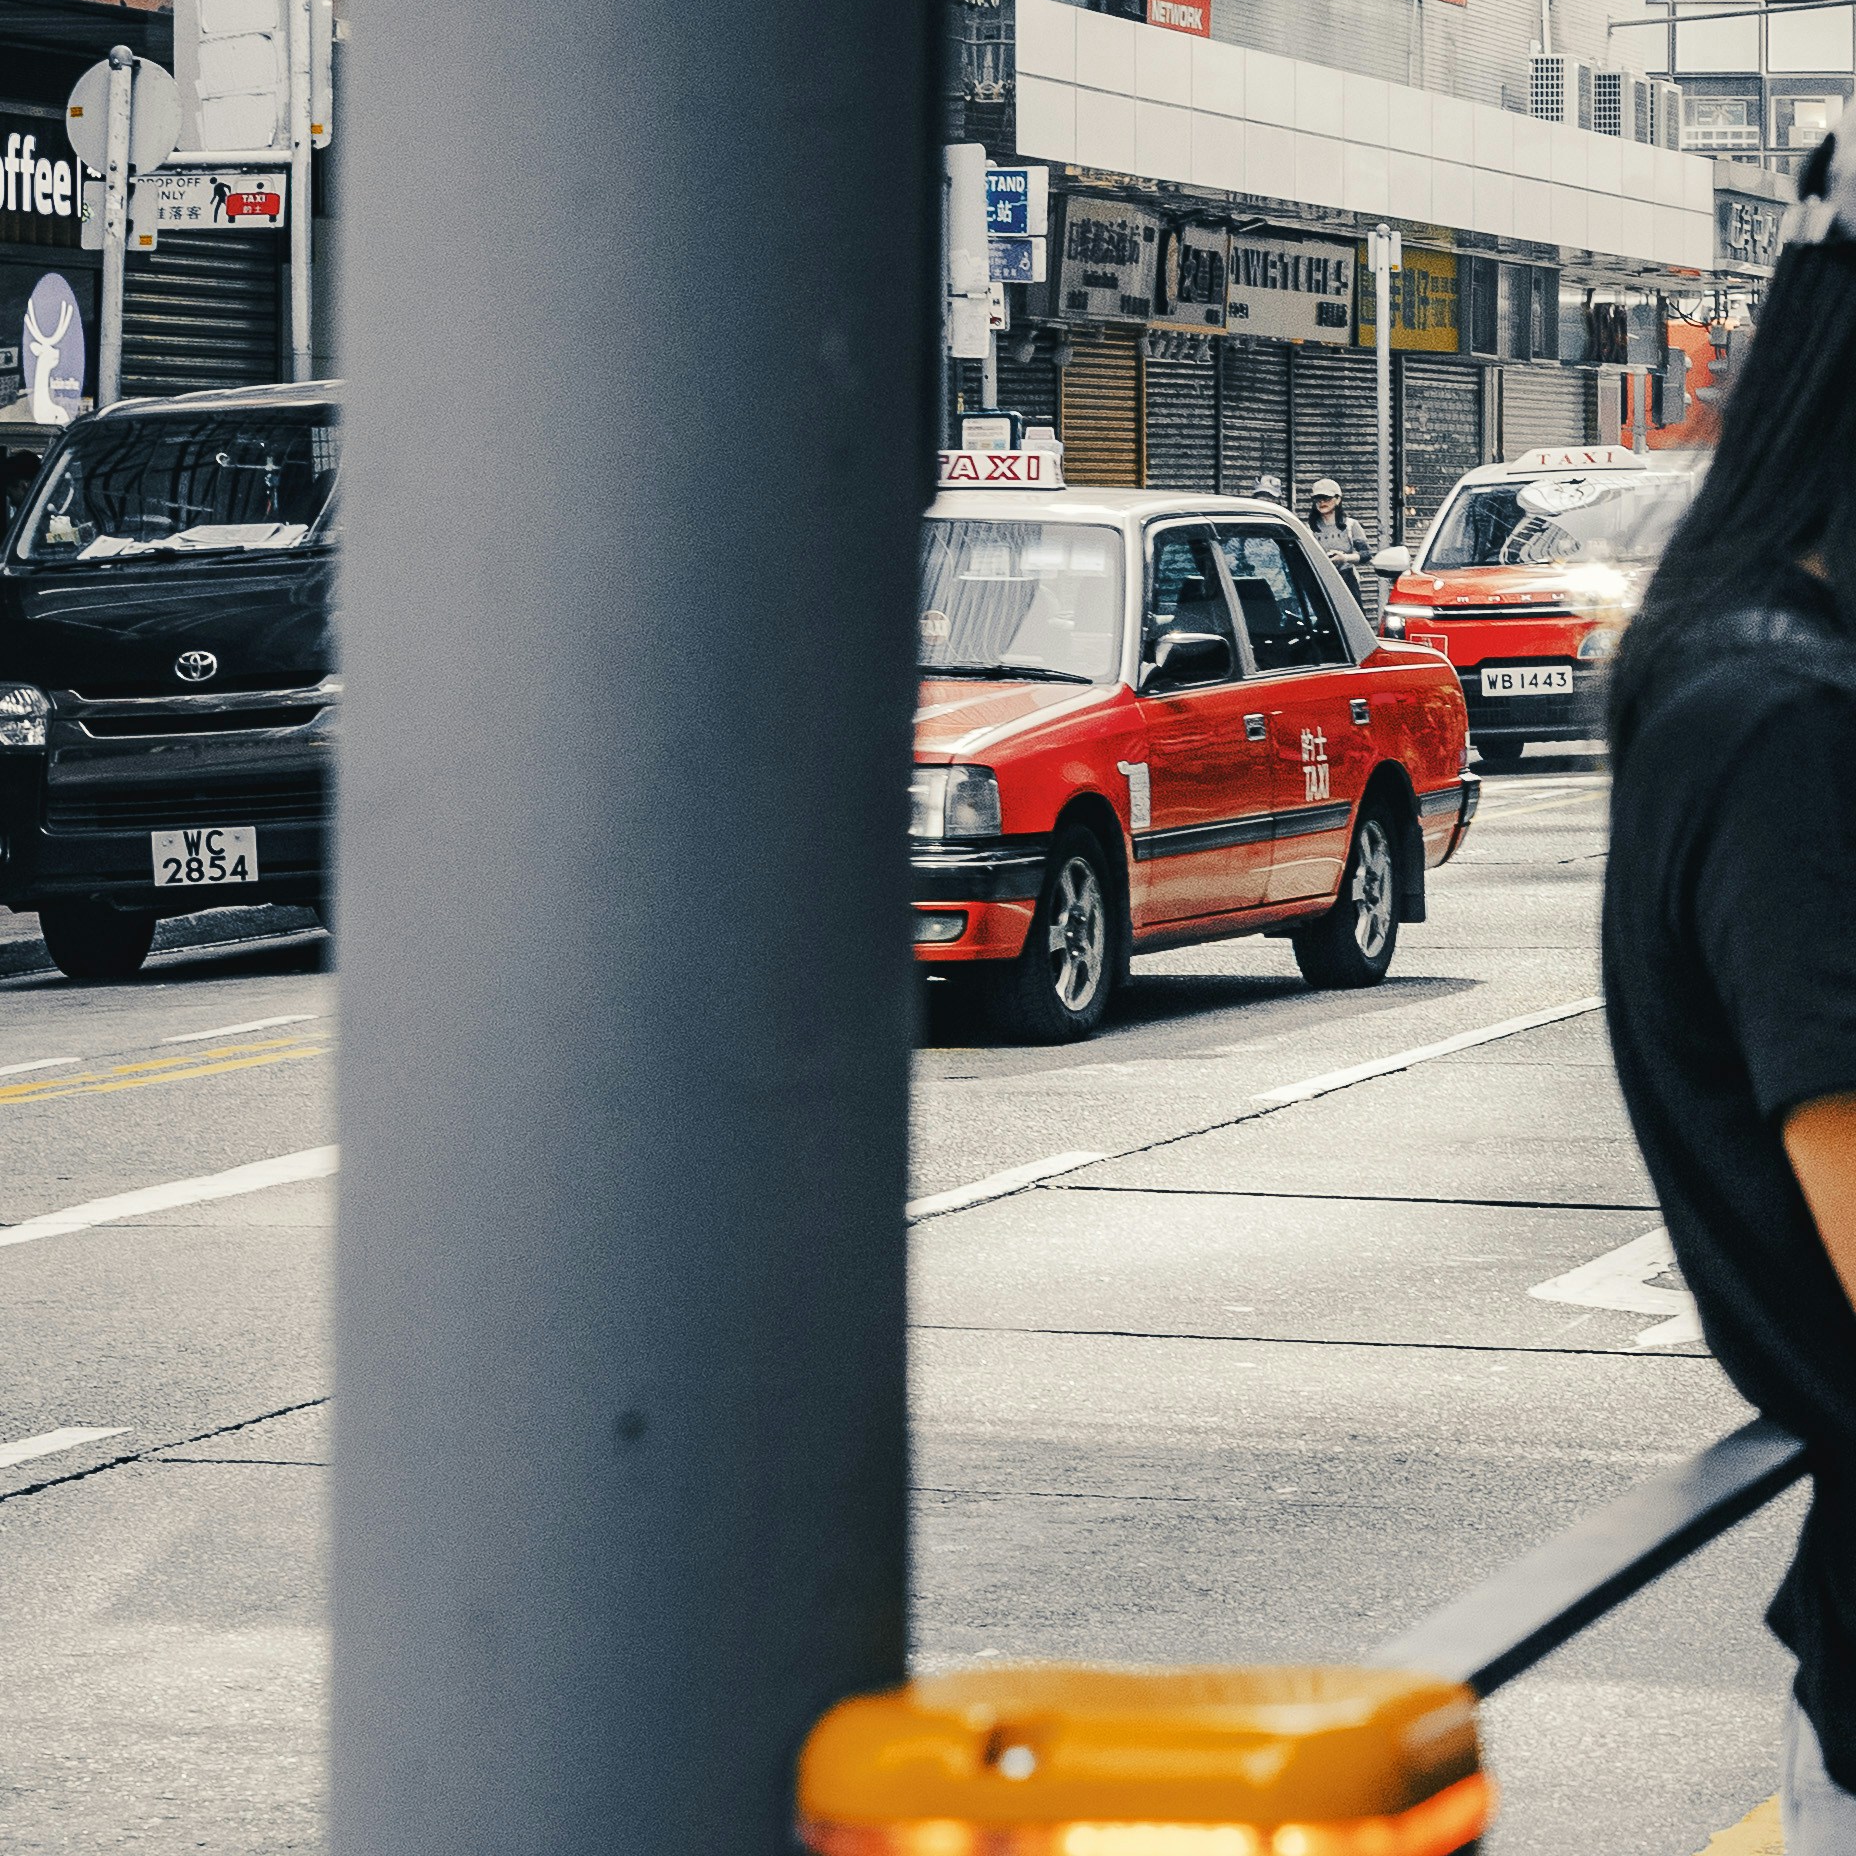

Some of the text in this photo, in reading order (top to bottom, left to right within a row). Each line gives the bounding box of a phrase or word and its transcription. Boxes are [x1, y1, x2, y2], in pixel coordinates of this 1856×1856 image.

[1151, 0, 1203, 31] NETWORK
[0, 132, 72, 217] ffee
[177, 177, 201, 188] OFF
[157, 190, 186, 201] NLY
[242, 194, 266, 203] TAXI
[1536, 451, 1614, 466] TAXI
[1487, 671, 1567, 690] WB 1443
[1300, 726, 1328, 762] 的士
[1302, 762, 1330, 802] TAXI
[183, 829, 225, 857] WC
[162, 856, 250, 883] 2854
